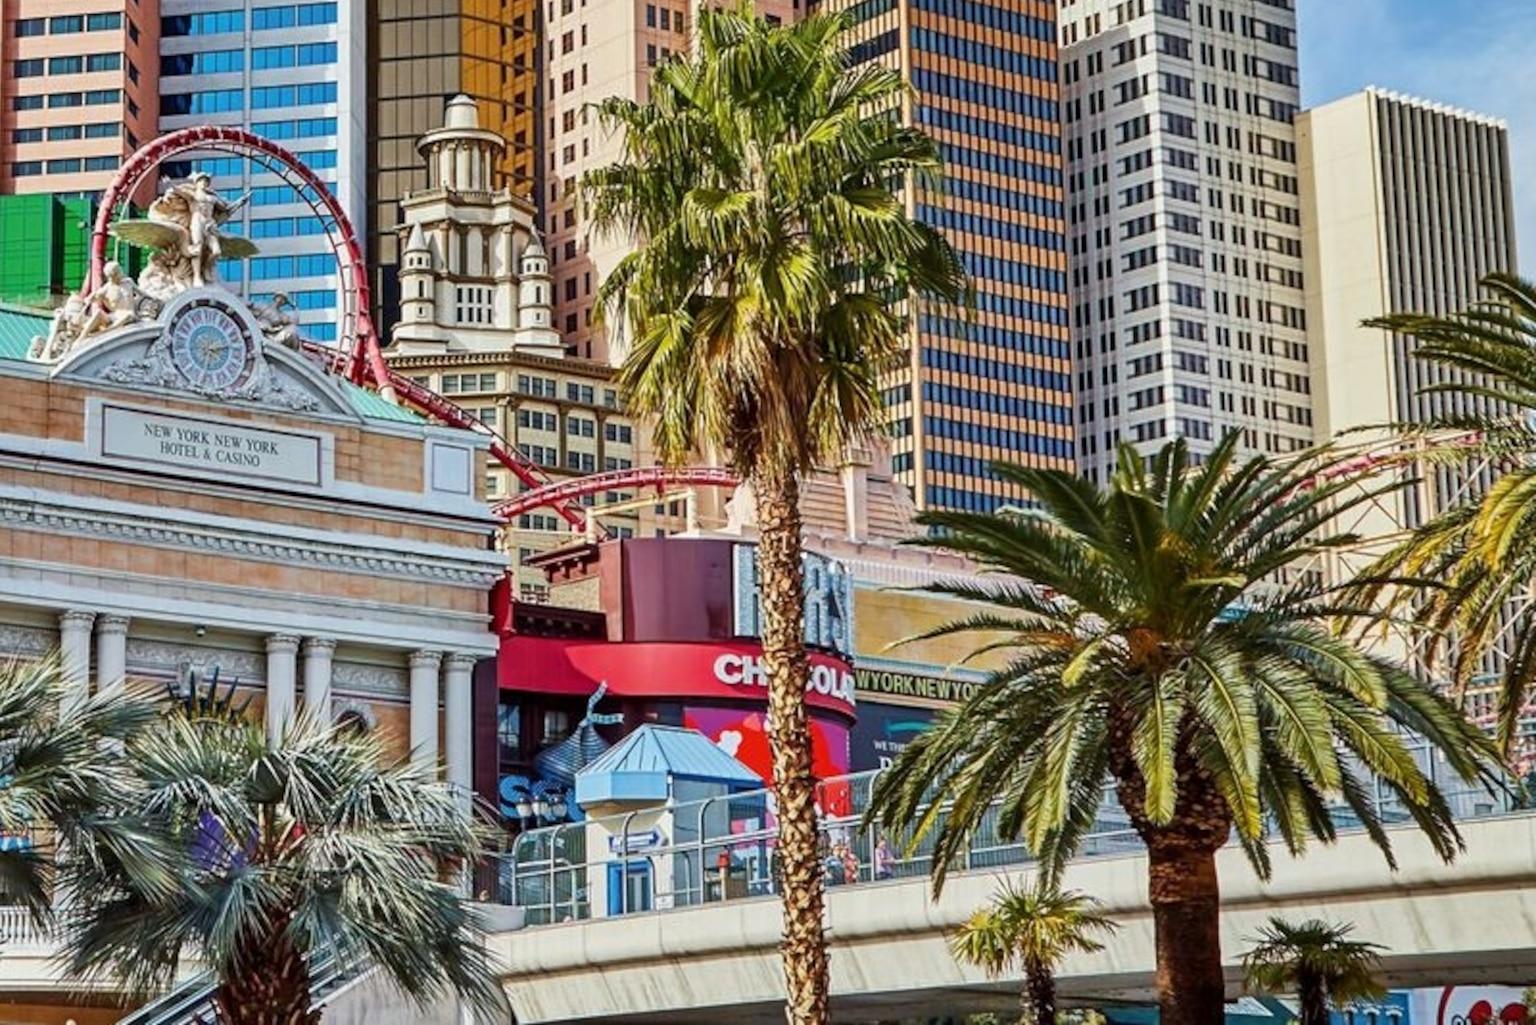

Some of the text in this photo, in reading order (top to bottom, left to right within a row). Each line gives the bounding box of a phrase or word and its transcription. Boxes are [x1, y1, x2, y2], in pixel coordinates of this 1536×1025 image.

[144, 423, 278, 455] NEW YORK NEW YORK
[160, 441, 260, 467] HOTEL & CASINO
